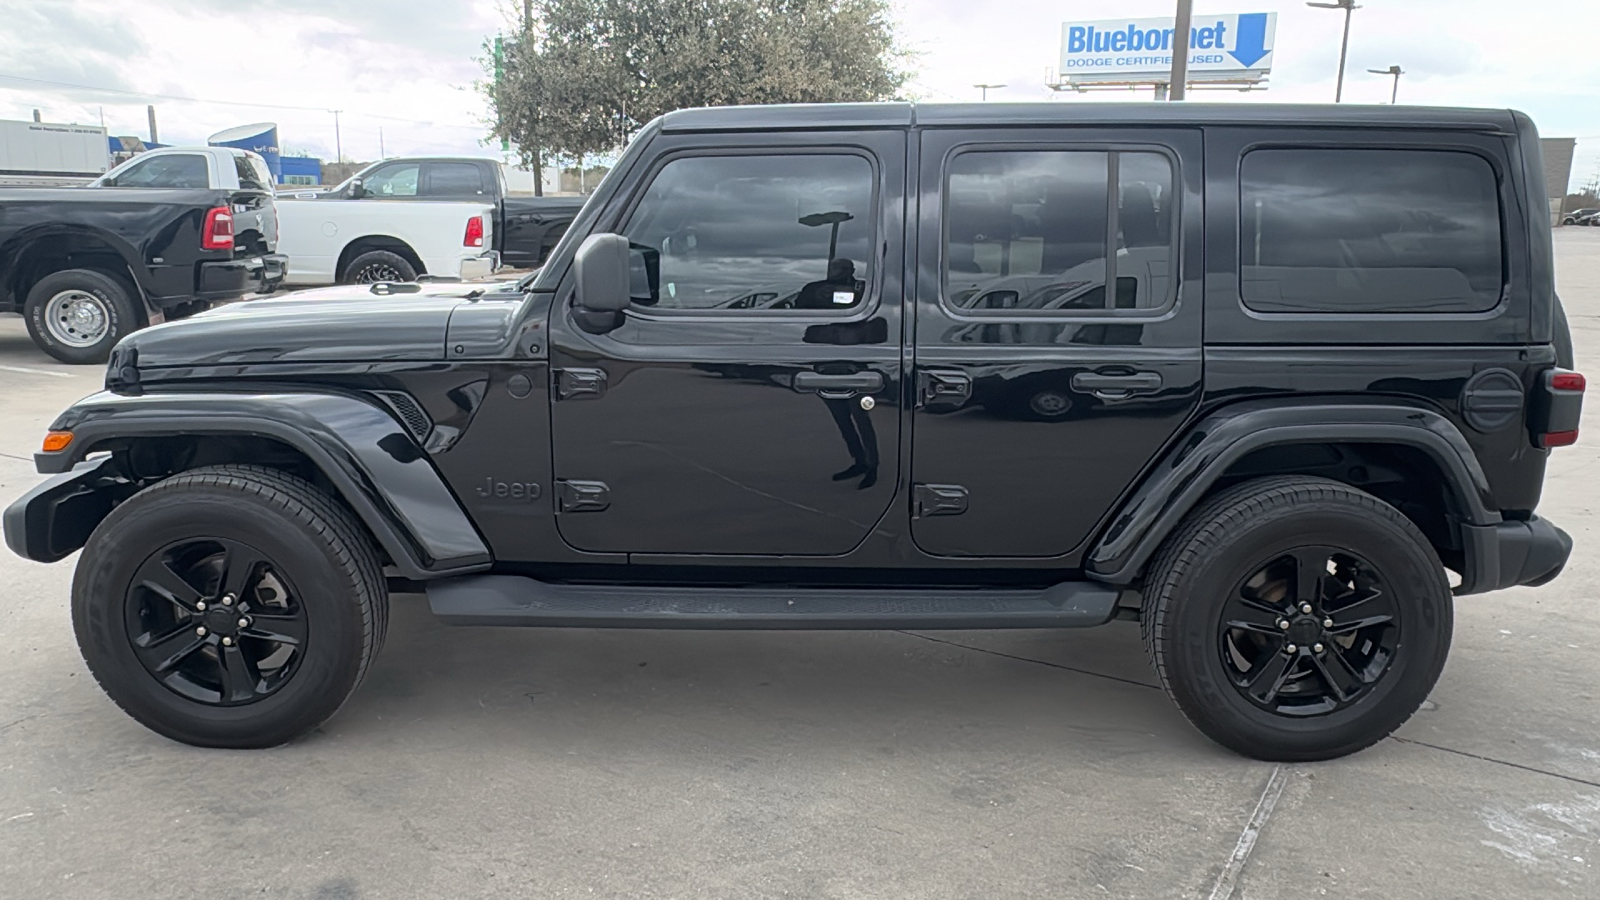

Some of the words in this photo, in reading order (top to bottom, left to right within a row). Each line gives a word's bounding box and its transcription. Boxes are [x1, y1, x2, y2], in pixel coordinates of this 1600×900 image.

[1067, 57, 1112, 67] DODGE
[1116, 56, 1173, 66] CERTIFIE
[477, 477, 541, 503] Jeep
